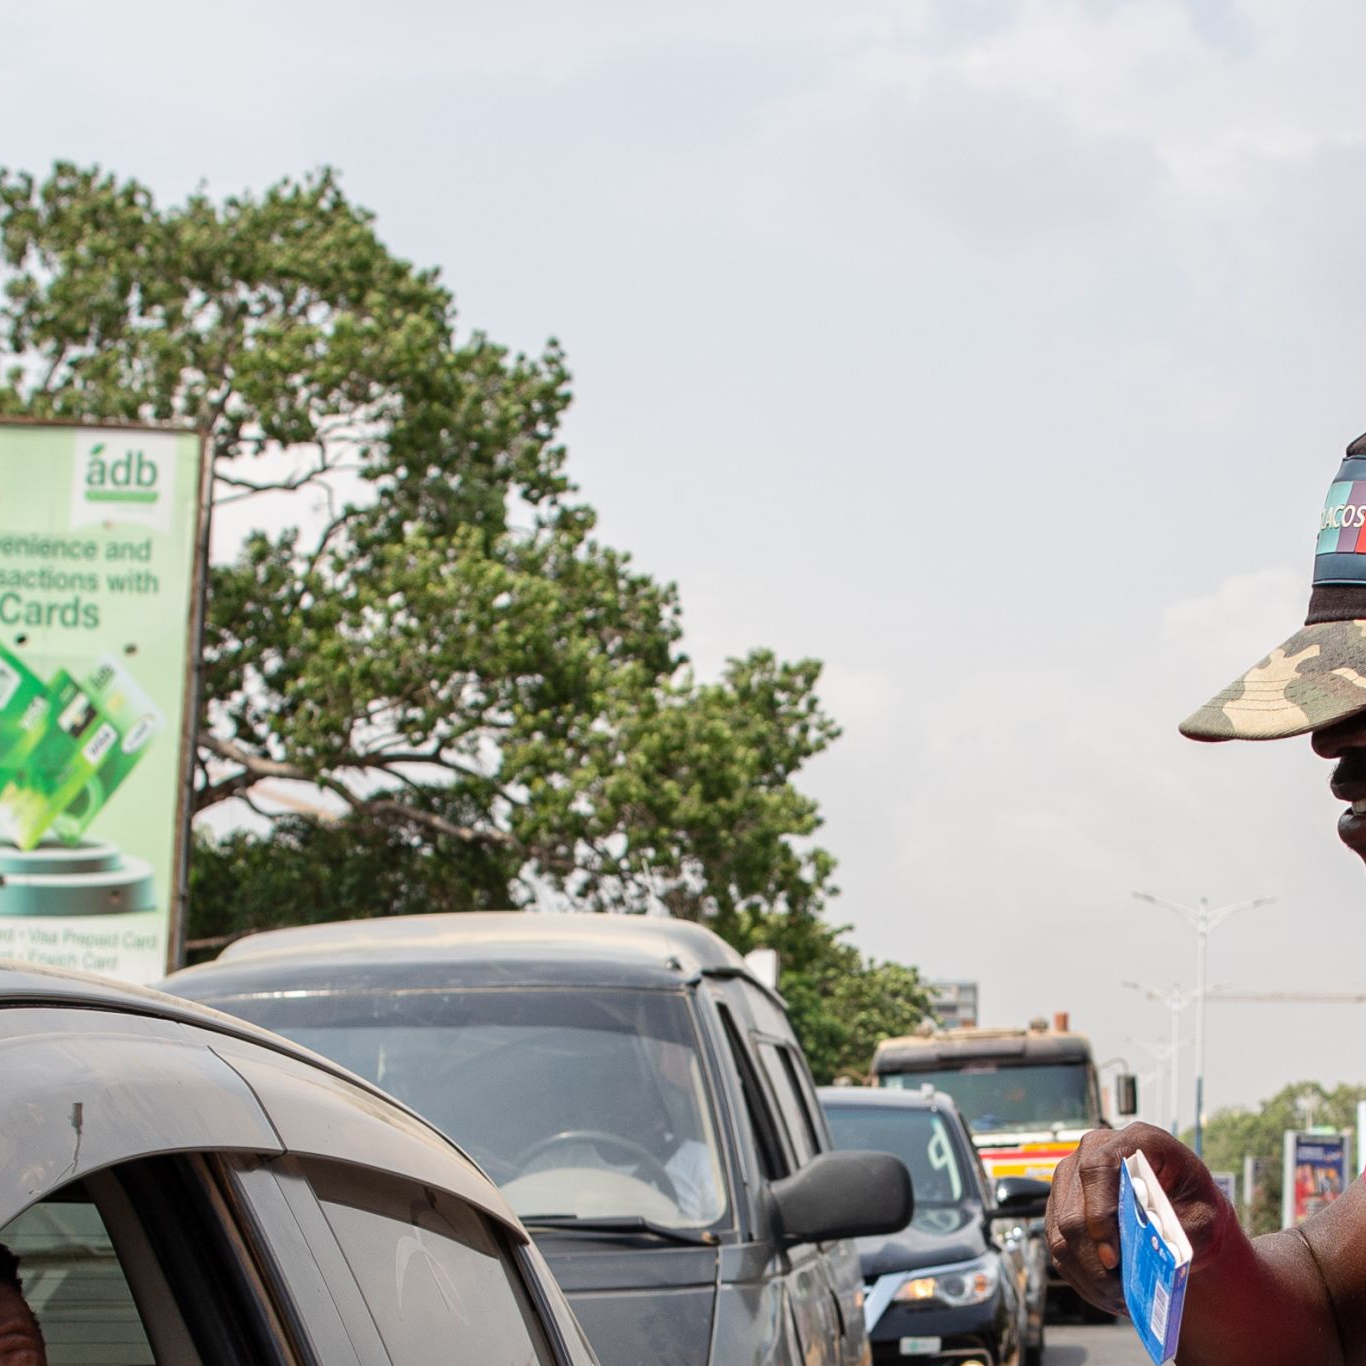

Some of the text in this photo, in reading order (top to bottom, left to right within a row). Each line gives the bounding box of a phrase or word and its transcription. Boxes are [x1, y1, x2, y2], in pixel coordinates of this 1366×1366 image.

[105, 537, 153, 563] and
[107, 567, 160, 595] with
[26, 926, 59, 944] Visa
[62, 927, 120, 950] Prepaid
[121, 929, 158, 950] Card
